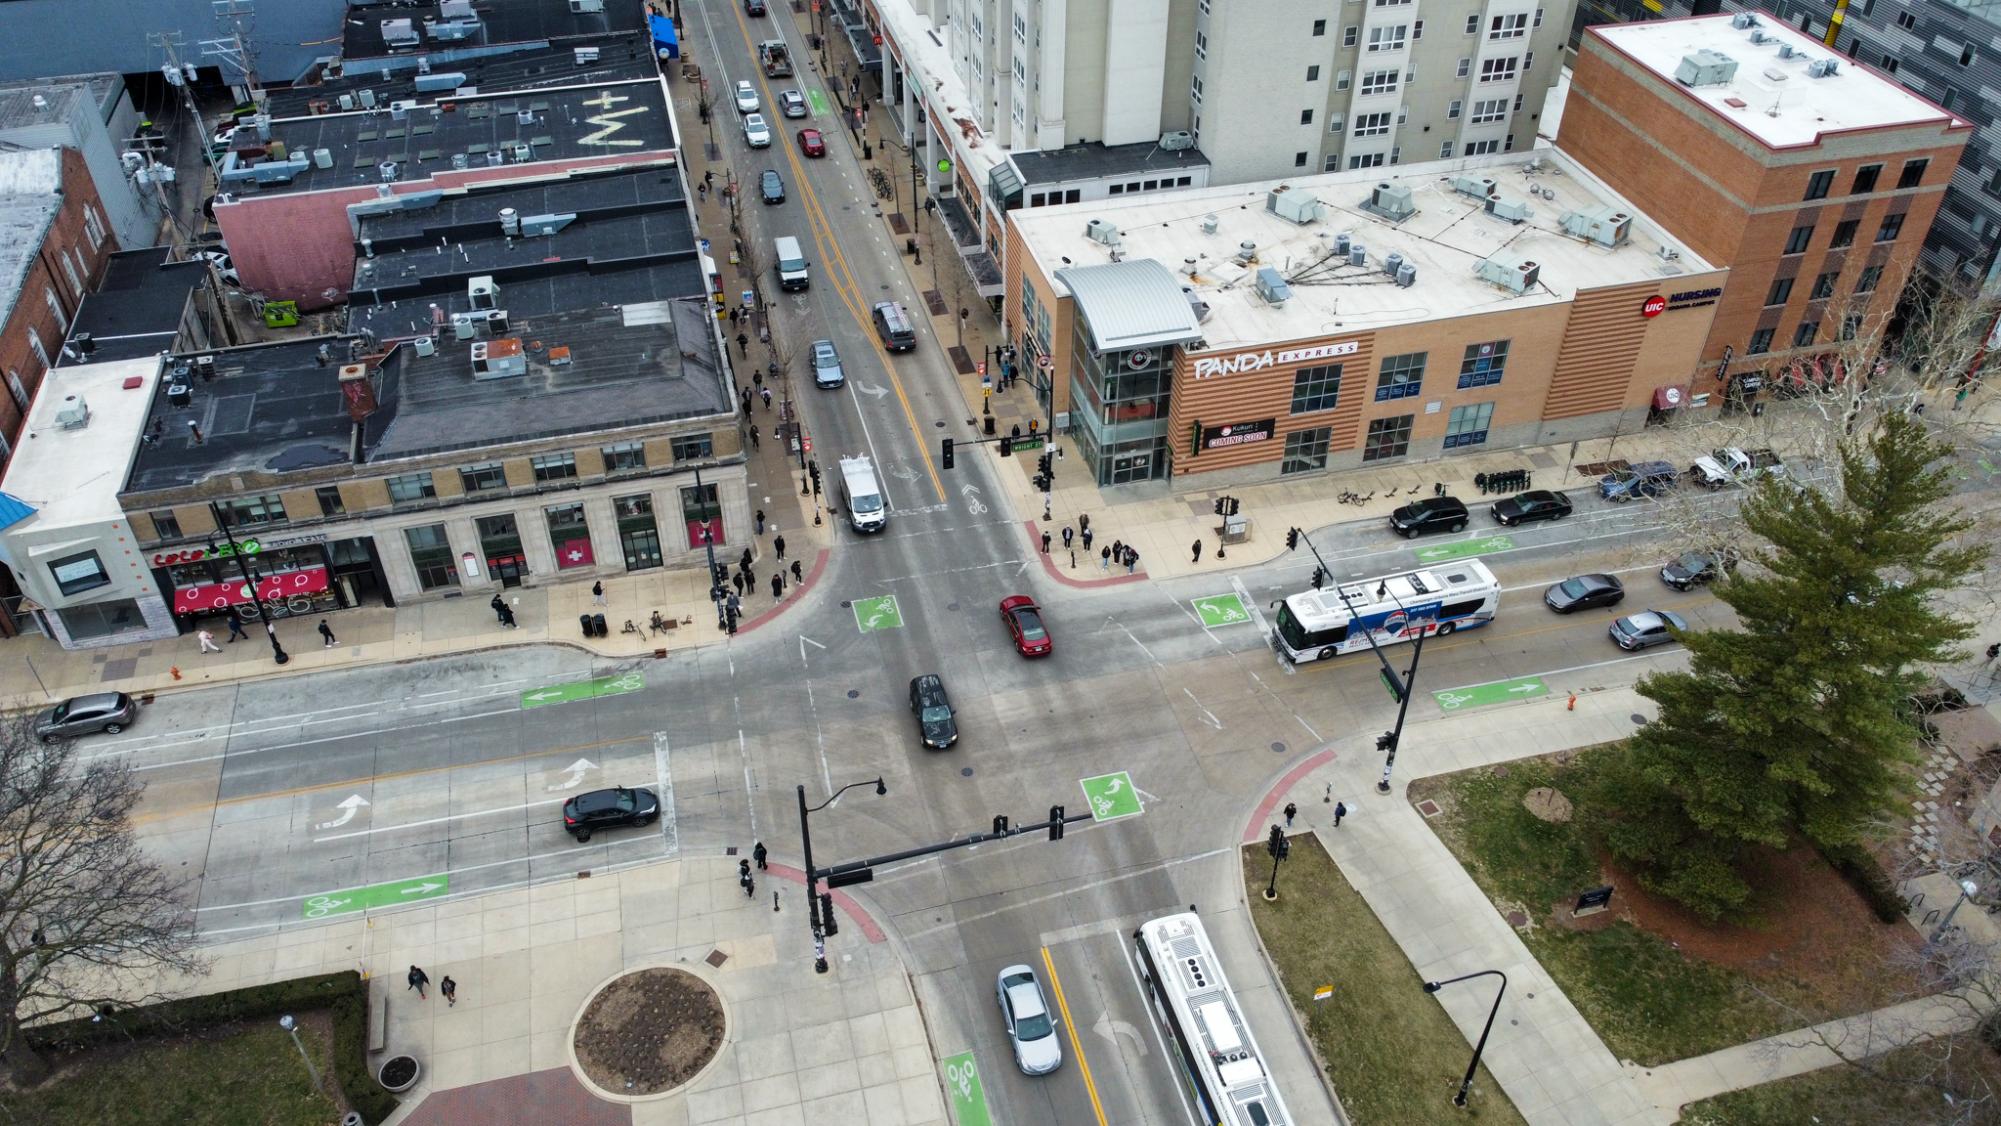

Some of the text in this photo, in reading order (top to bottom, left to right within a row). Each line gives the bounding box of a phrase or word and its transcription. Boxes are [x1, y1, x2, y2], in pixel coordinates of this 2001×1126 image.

[1670, 288, 1722, 303] NURSING
[1645, 303, 1664, 312] UIC
[1193, 344, 1354, 379] PANDA EXPRESS
[1014, 442, 1033, 450] WRIGHT
[1208, 435, 1243, 448] COMING
[1243, 431, 1267, 442] SOON
